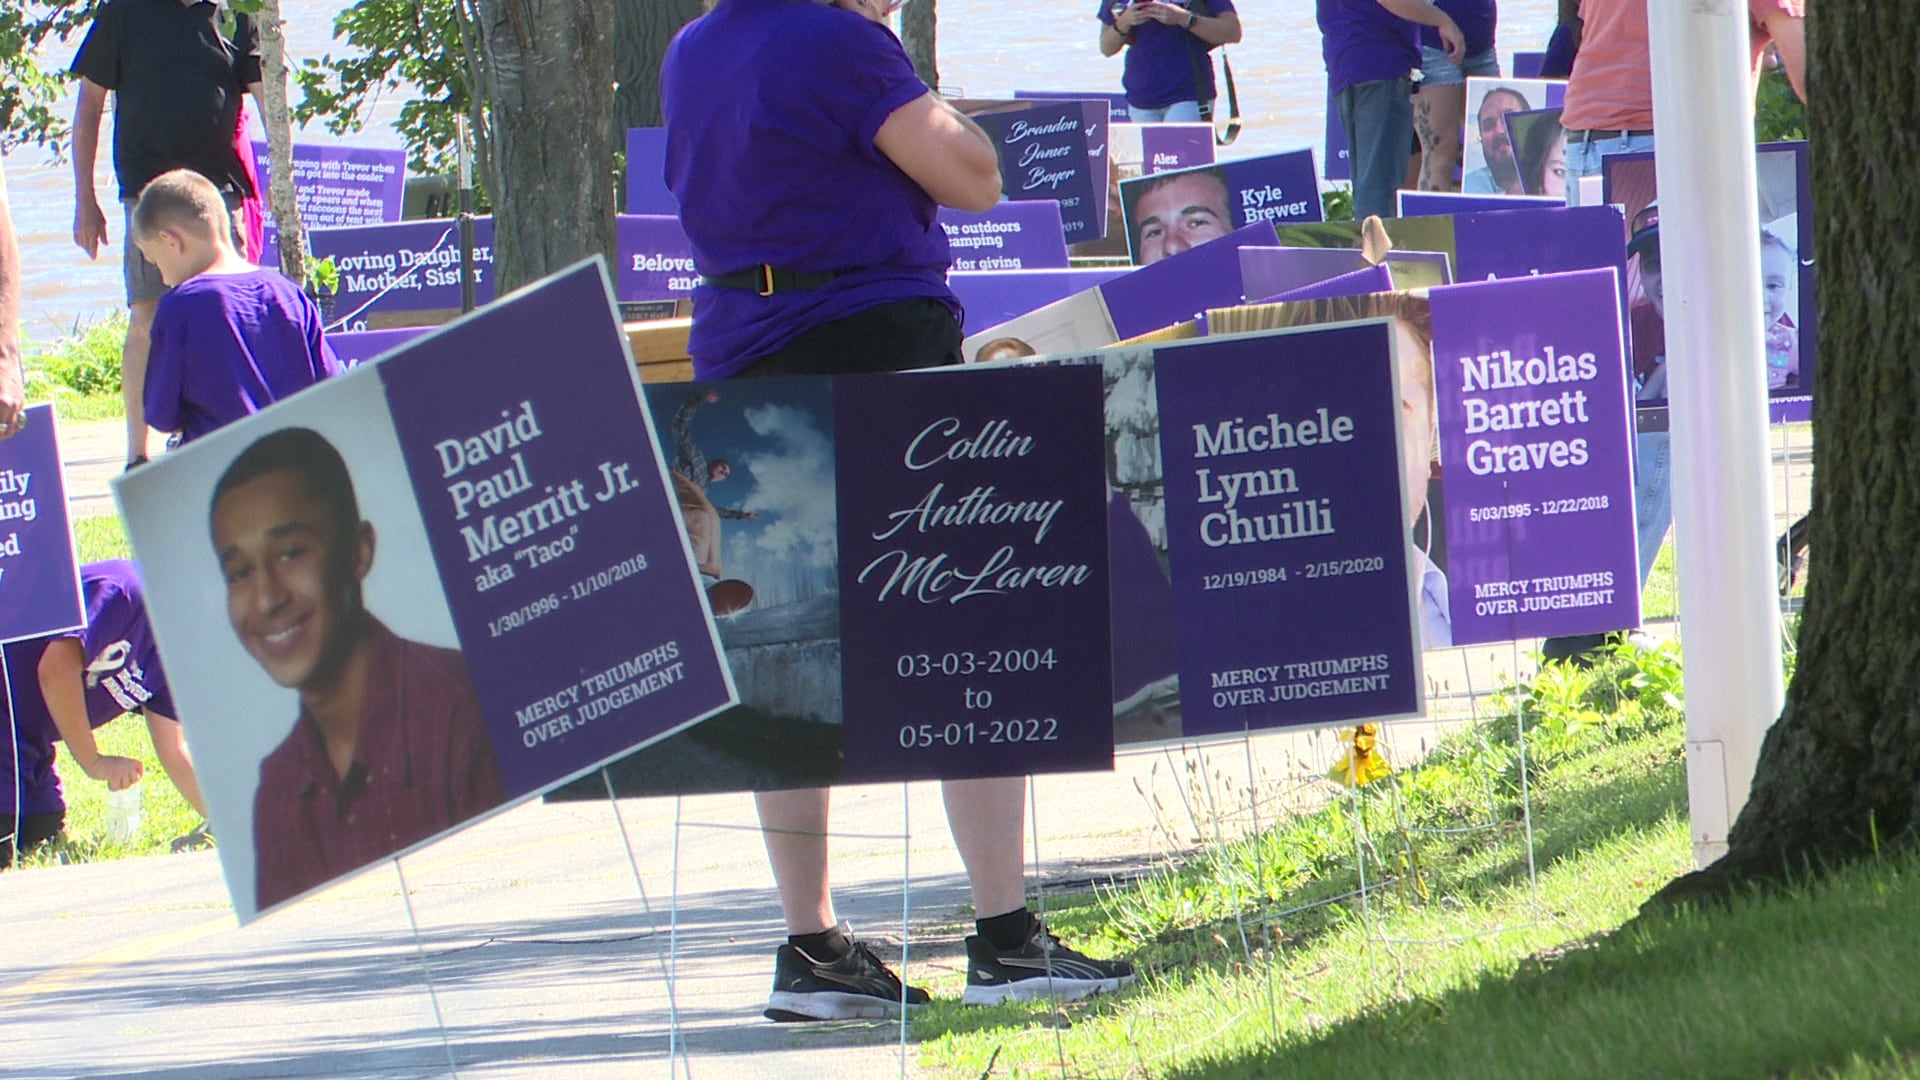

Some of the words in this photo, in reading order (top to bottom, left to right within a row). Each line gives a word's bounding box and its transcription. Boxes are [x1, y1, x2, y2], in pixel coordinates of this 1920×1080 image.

[1005, 115, 1078, 143] Brandon
[321, 160, 341, 171] with
[343, 161, 371, 173] Trevor
[372, 163, 395, 175] when
[1018, 142, 1071, 167] James
[1153, 152, 1178, 165] Alex
[306, 170, 322, 180] got
[322, 170, 341, 180] into
[342, 171, 356, 181] the
[1022, 166, 1075, 190] Boyer
[298, 184, 316, 194] and
[317, 185, 346, 197] Trevor
[346, 186, 371, 198] made
[312, 195, 341, 206] spears
[342, 196, 359, 206] and
[360, 197, 384, 208] when
[1240, 185, 1283, 207] Kyle
[308, 204, 347, 215] raccoons
[348, 205, 363, 216] the
[320, 212, 335, 222] out
[336, 213, 346, 223] of
[1243, 201, 1308, 224] Brewer
[941, 221, 960, 235] he
[961, 220, 1021, 234] outdoors
[329, 250, 397, 273] Loving
[398, 245, 494, 268] Daugher,
[632, 252, 695, 272] Belove
[956, 257, 976, 270] for
[979, 256, 1022, 271] giving
[345, 270, 422, 293] Mother,
[425, 268, 483, 287] Sistr
[1459, 346, 1598, 393] Nikolas
[1463, 390, 1590, 435] Barrett
[434, 400, 544, 478] David
[903, 416, 1037, 471] Collin
[1192, 407, 1355, 459] Michele
[1466, 438, 1589, 476] Graves
[448, 452, 534, 521] Paul
[1195, 467, 1300, 510] Lynn
[460, 478, 592, 563] Merritt
[594, 460, 640, 503] Jr.
[872, 482, 1064, 545] Anthony
[1199, 498, 1336, 548] Chuilli
[1470, 503, 1532, 522] 5/03/1995
[1542, 495, 1610, 516] 12/22/2018
[475, 560, 516, 593] aka
[856, 545, 1092, 605] McLaren
[1203, 566, 1288, 590] 12/19/1984
[1304, 556, 1385, 580] 2/15/2020
[1475, 579, 1530, 599] MERCY
[1531, 571, 1615, 593] TRIUMPHS
[487, 593, 560, 638] 1/30/1996
[570, 553, 648, 601] 11/10/2018
[1475, 599, 1519, 617] OVER
[1520, 589, 1615, 613] JUDGEMENT
[897, 648, 1058, 678] 03-03-2004
[1211, 666, 1280, 689] MERCY
[1284, 653, 1390, 681] TRIUMPHS
[515, 686, 581, 728] MERCY
[581, 640, 680, 697] TRIUMPHS
[963, 686, 993, 710] to
[1212, 688, 1266, 709] OVER
[1268, 674, 1391, 702] JUDGEMENT
[522, 711, 574, 749] OVER
[576, 661, 685, 727] JUDGEMENT
[899, 717, 1059, 748] 05-01-2022
